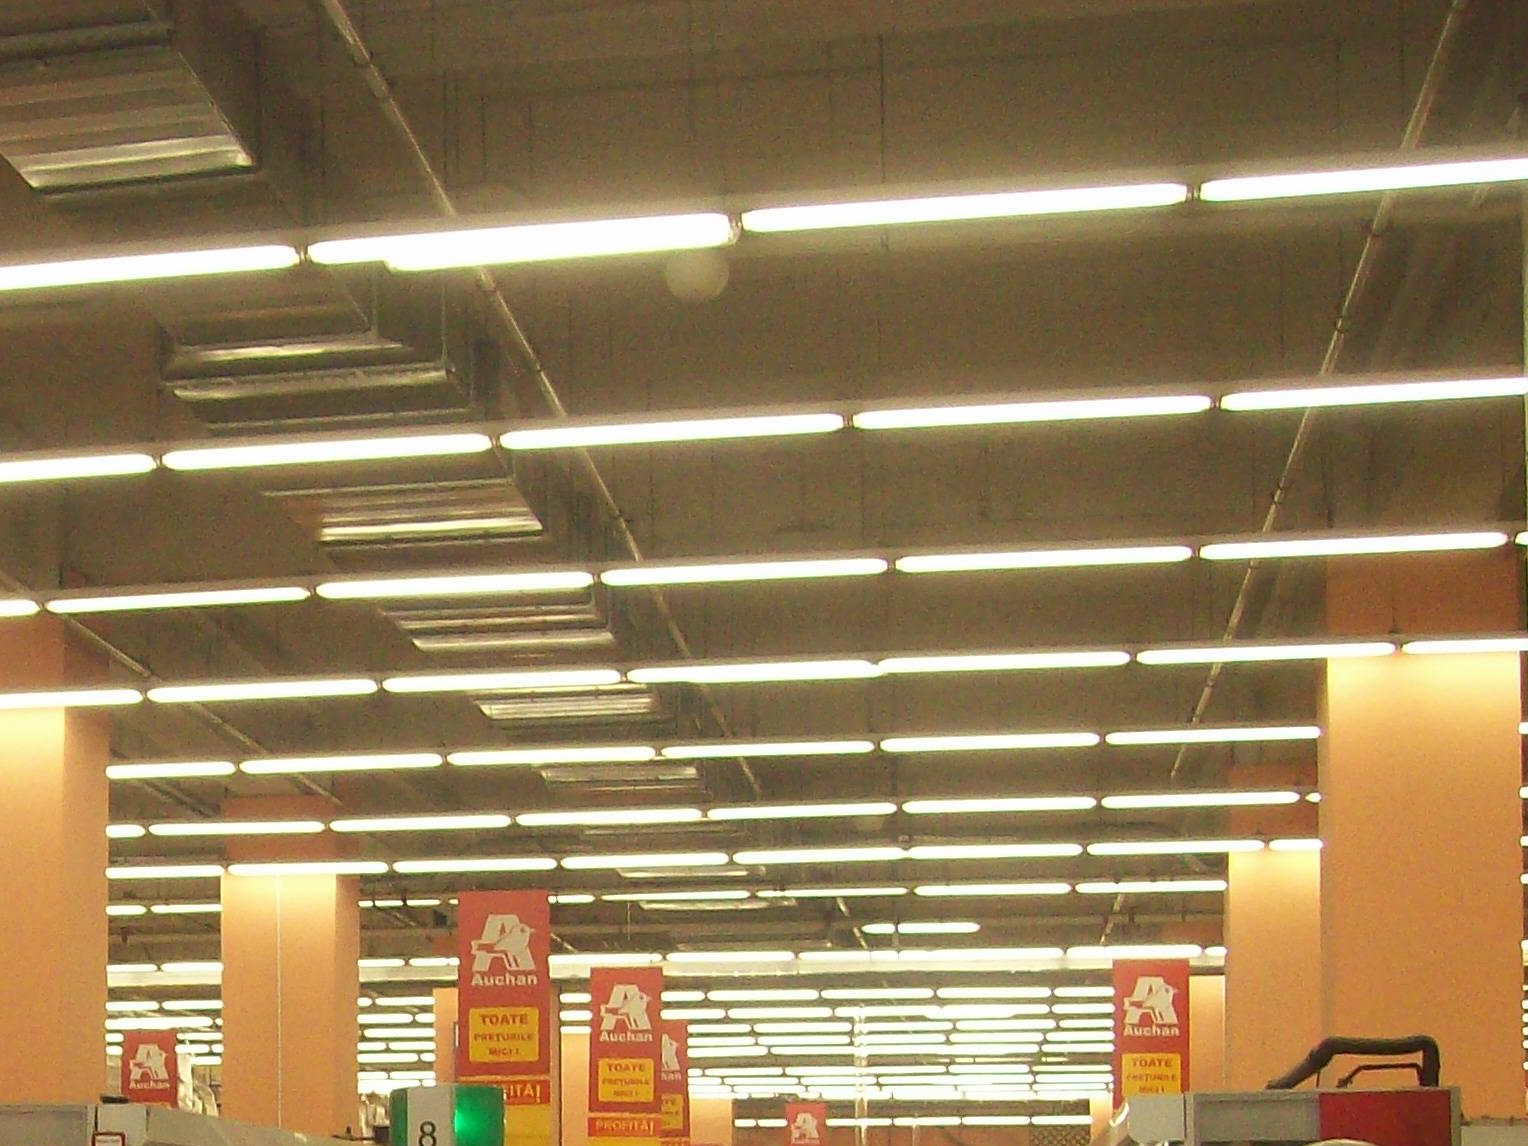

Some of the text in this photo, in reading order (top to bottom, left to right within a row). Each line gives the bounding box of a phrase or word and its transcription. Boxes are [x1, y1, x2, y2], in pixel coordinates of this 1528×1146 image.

[471, 972, 538, 986] Auchan
[480, 1013, 529, 1025] TOATE
[1123, 1024, 1180, 1036] Auchan
[600, 1031, 654, 1043] Auchan
[607, 1063, 646, 1072] TOATE
[1132, 1058, 1173, 1067] TOATE
